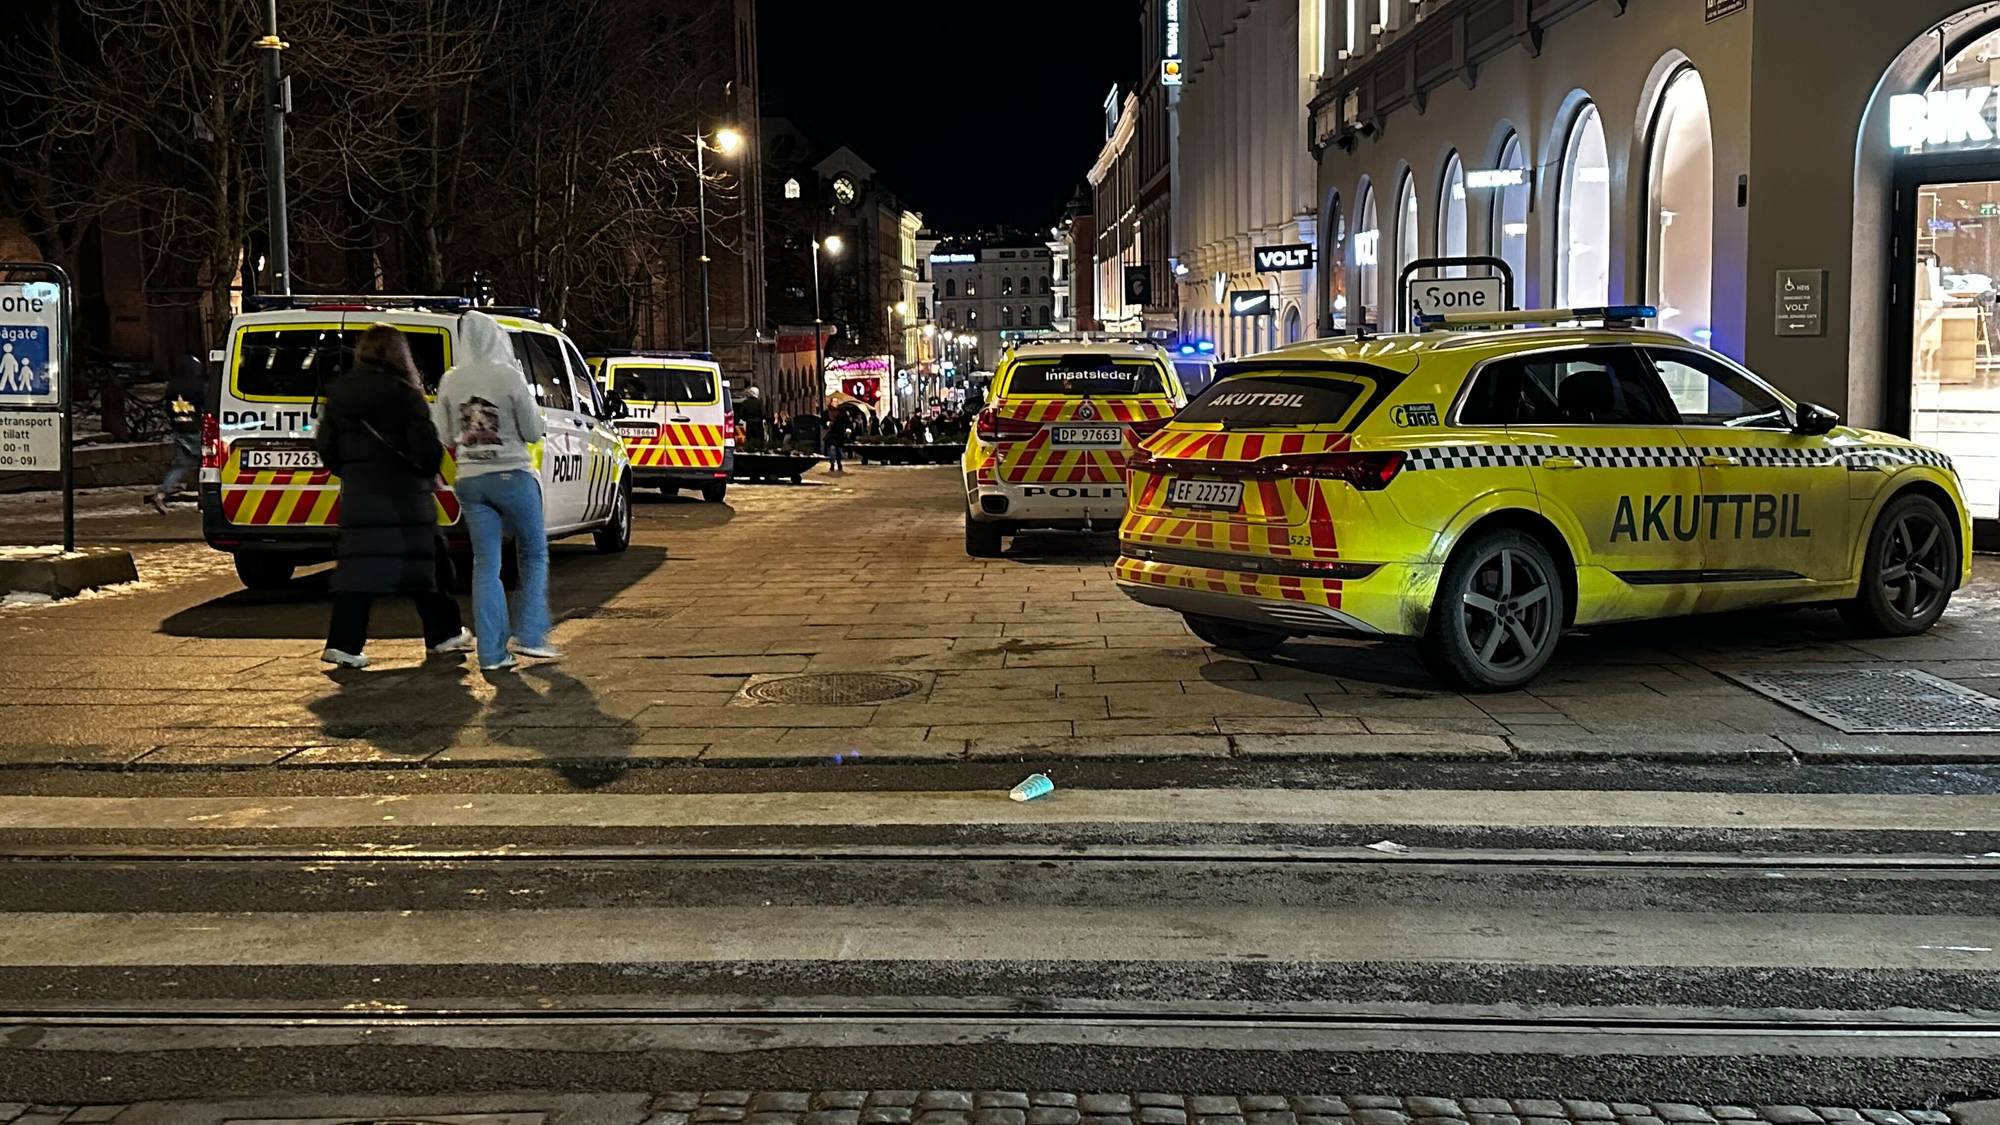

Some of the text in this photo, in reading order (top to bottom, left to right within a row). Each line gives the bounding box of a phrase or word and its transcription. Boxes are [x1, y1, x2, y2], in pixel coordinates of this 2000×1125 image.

[1259, 249, 1308, 267] VOLT
[2, 296, 43, 312] one
[1426, 287, 1485, 307] Sone
[1785, 303, 1809, 311] VOLT
[1, 327, 38, 341] ågate
[1045, 369, 1131, 381] Innsatsleder
[1208, 393, 1304, 408] AKUTTBIL
[0, 416, 52, 428] etransport
[223, 410, 309, 431] POLITI
[1409, 415, 1437, 425] 113
[3, 430, 30, 439] tillatt
[1062, 430, 1117, 440] DP 97663
[253, 452, 319, 465] DS 17263
[552, 455, 583, 483] POLITI
[1177, 483, 1237, 503] EF 22757
[1609, 493, 1812, 543] AKUTTBIL
[1291, 535, 1312, 546] 523
